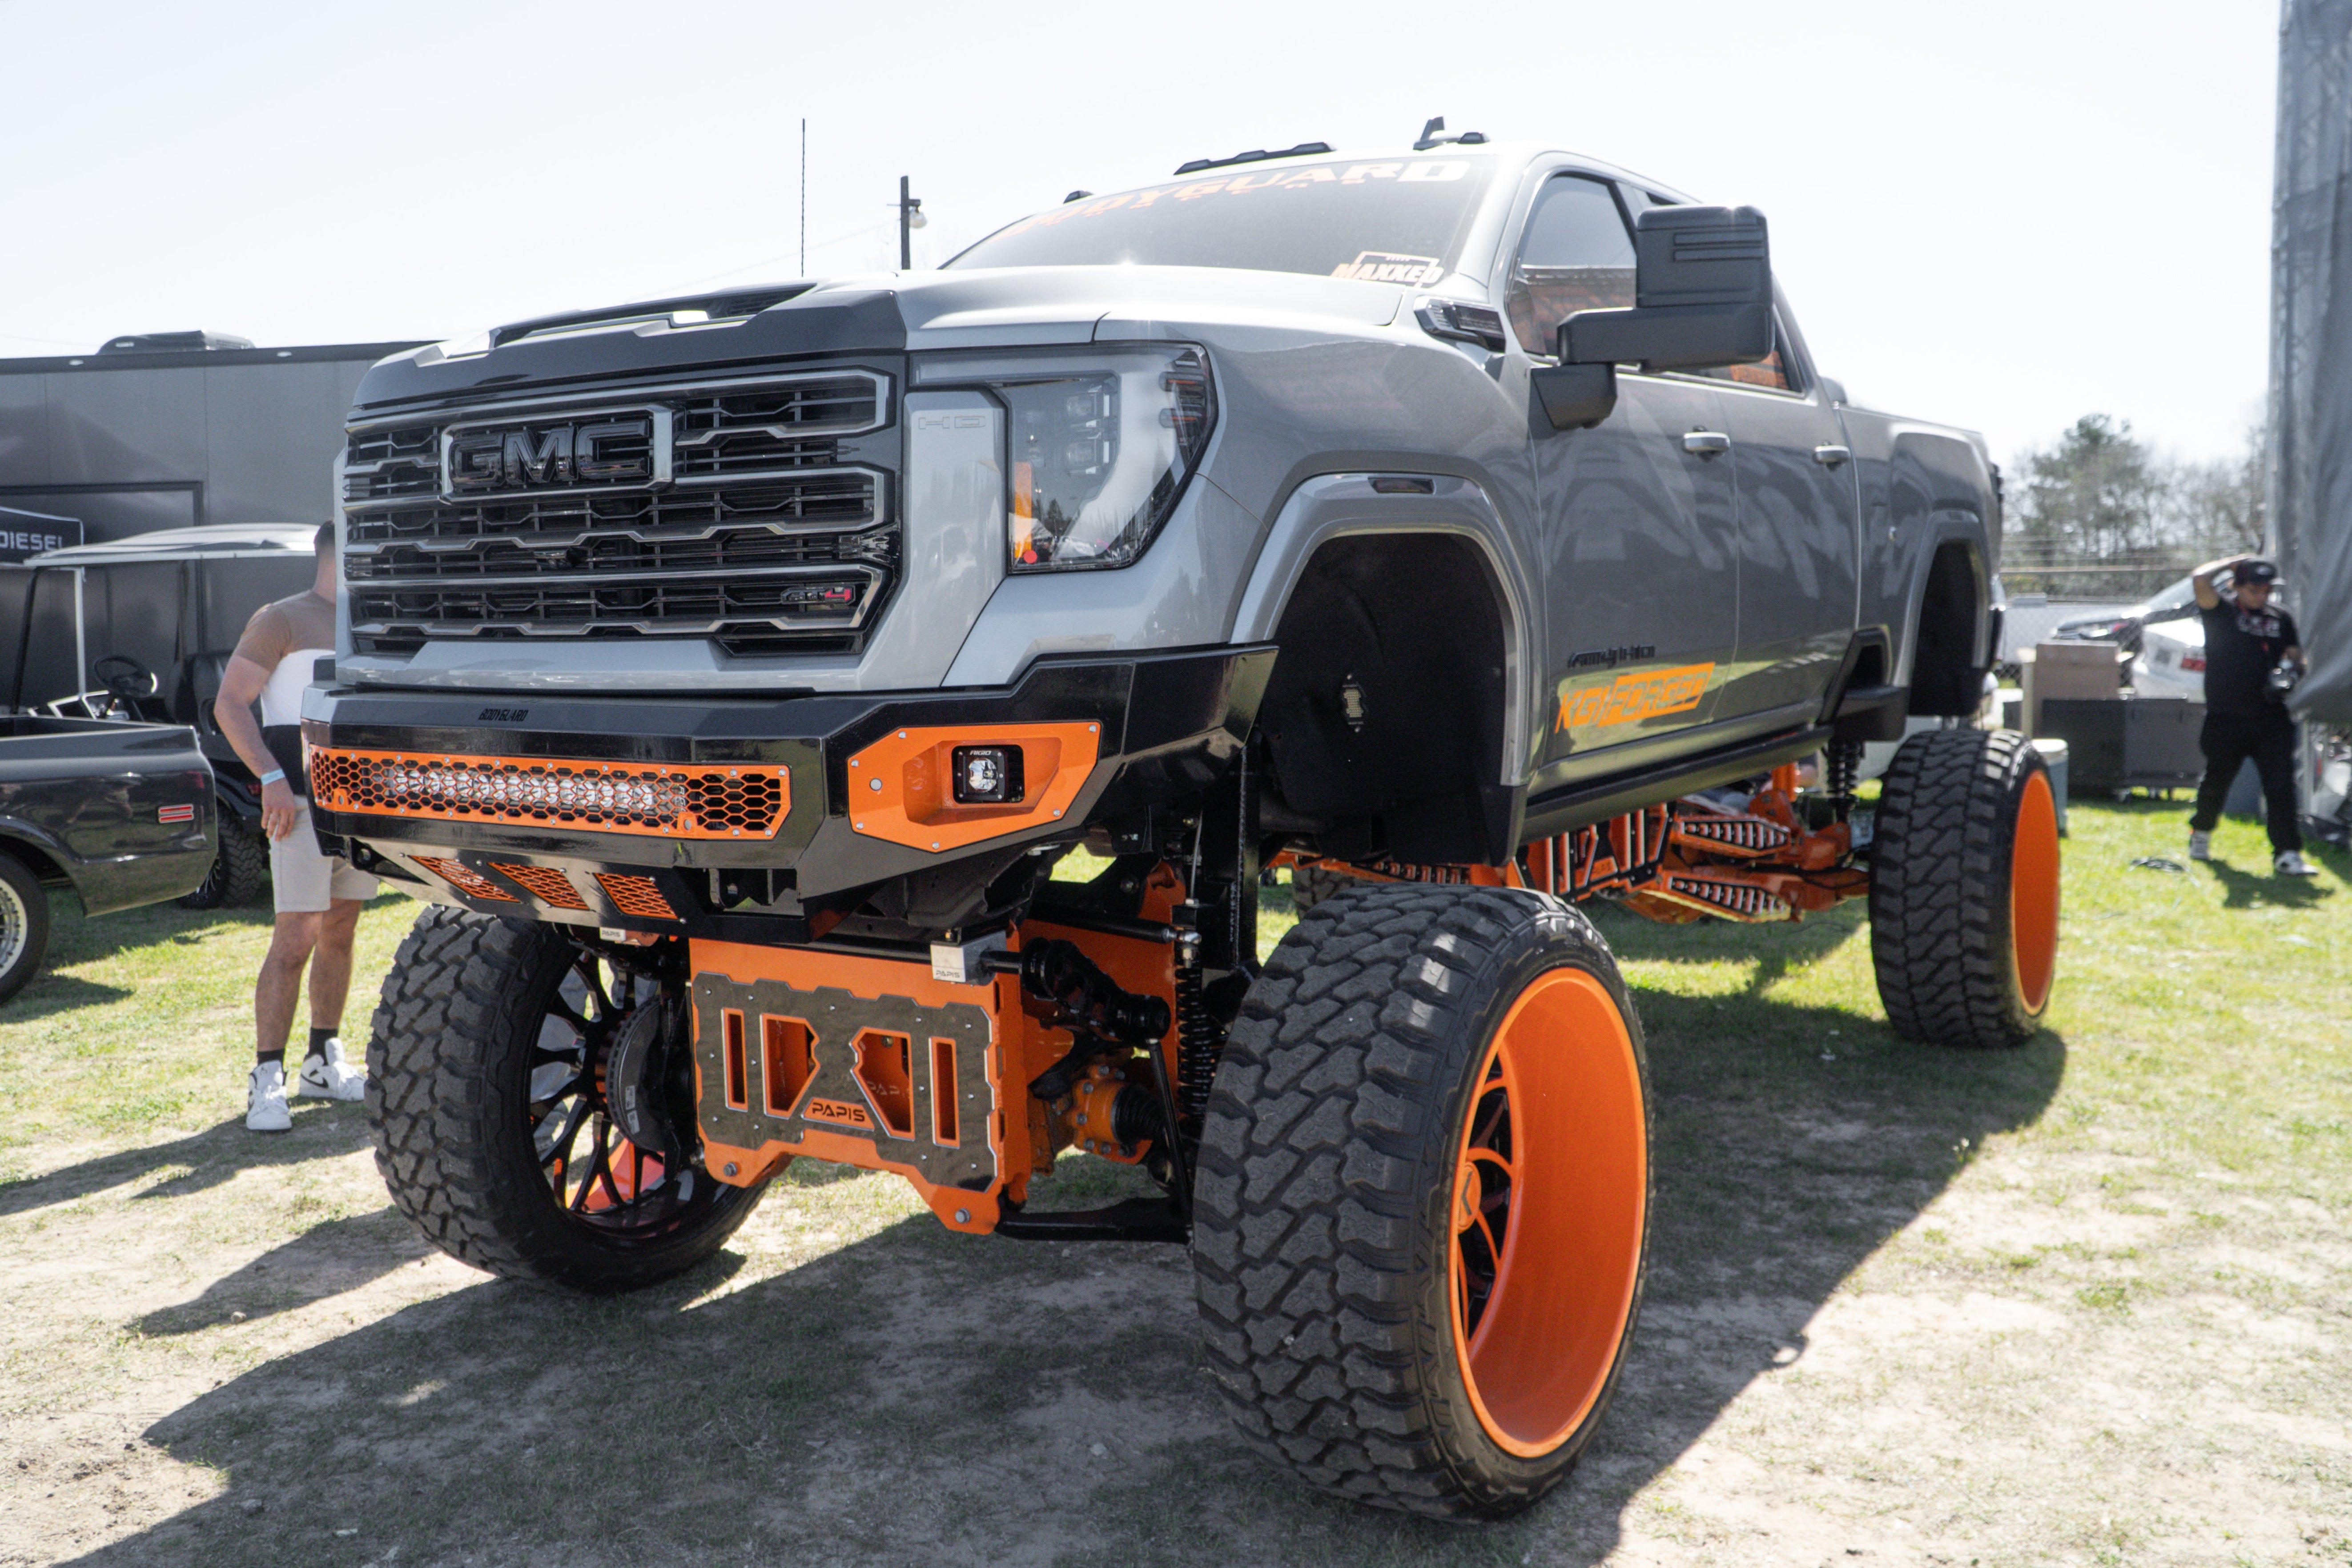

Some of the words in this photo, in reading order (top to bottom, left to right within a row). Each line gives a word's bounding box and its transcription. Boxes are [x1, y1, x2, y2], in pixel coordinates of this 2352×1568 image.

[1330, 263, 1444, 284] MAXXED
[918, 415, 986, 430] HD
[448, 419, 650, 488] GMC
[1603, 671, 1709, 720] FORGED
[478, 708, 529, 722] BODYGUARD
[812, 1102, 865, 1122] PAPIS
